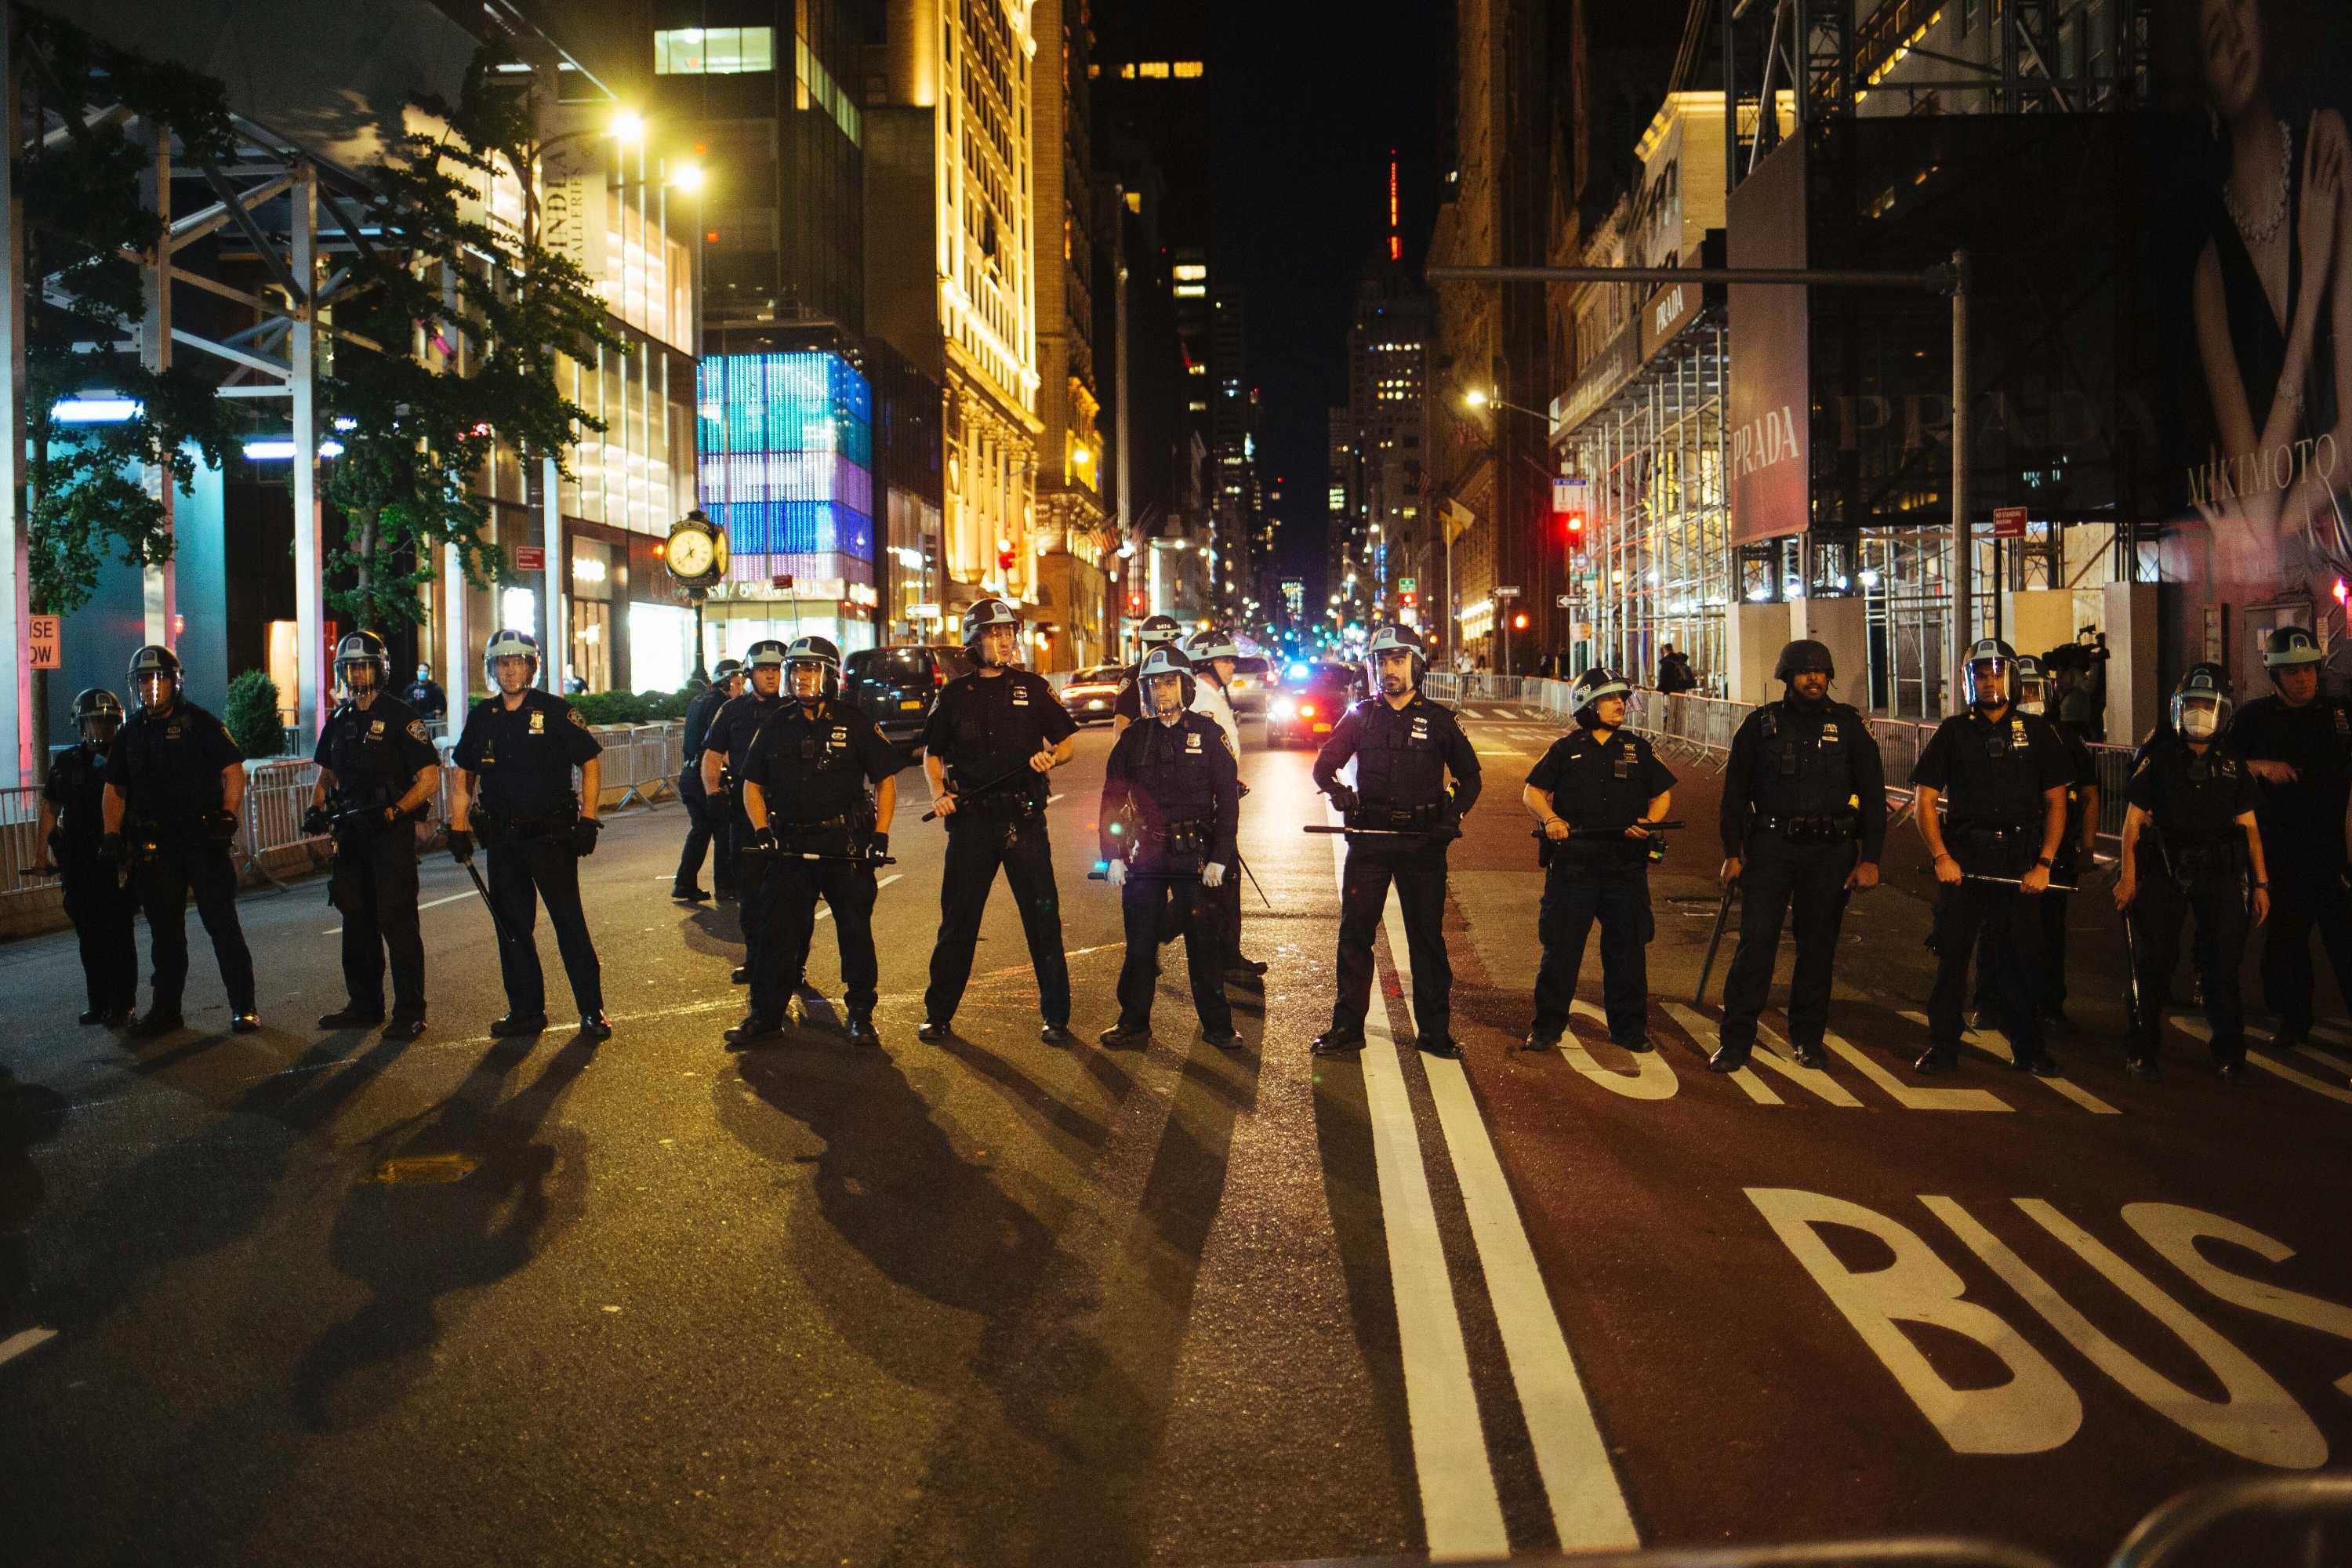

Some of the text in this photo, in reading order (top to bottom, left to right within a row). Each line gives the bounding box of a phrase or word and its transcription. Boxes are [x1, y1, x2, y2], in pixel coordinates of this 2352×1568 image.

[1656, 285, 1684, 336] PRADA
[1733, 406, 1800, 479] PRADA
[2187, 434, 2336, 506] MIKIMOTO
[1557, 998, 2122, 1114] ONLY
[1742, 1187, 2352, 1469] BUS
